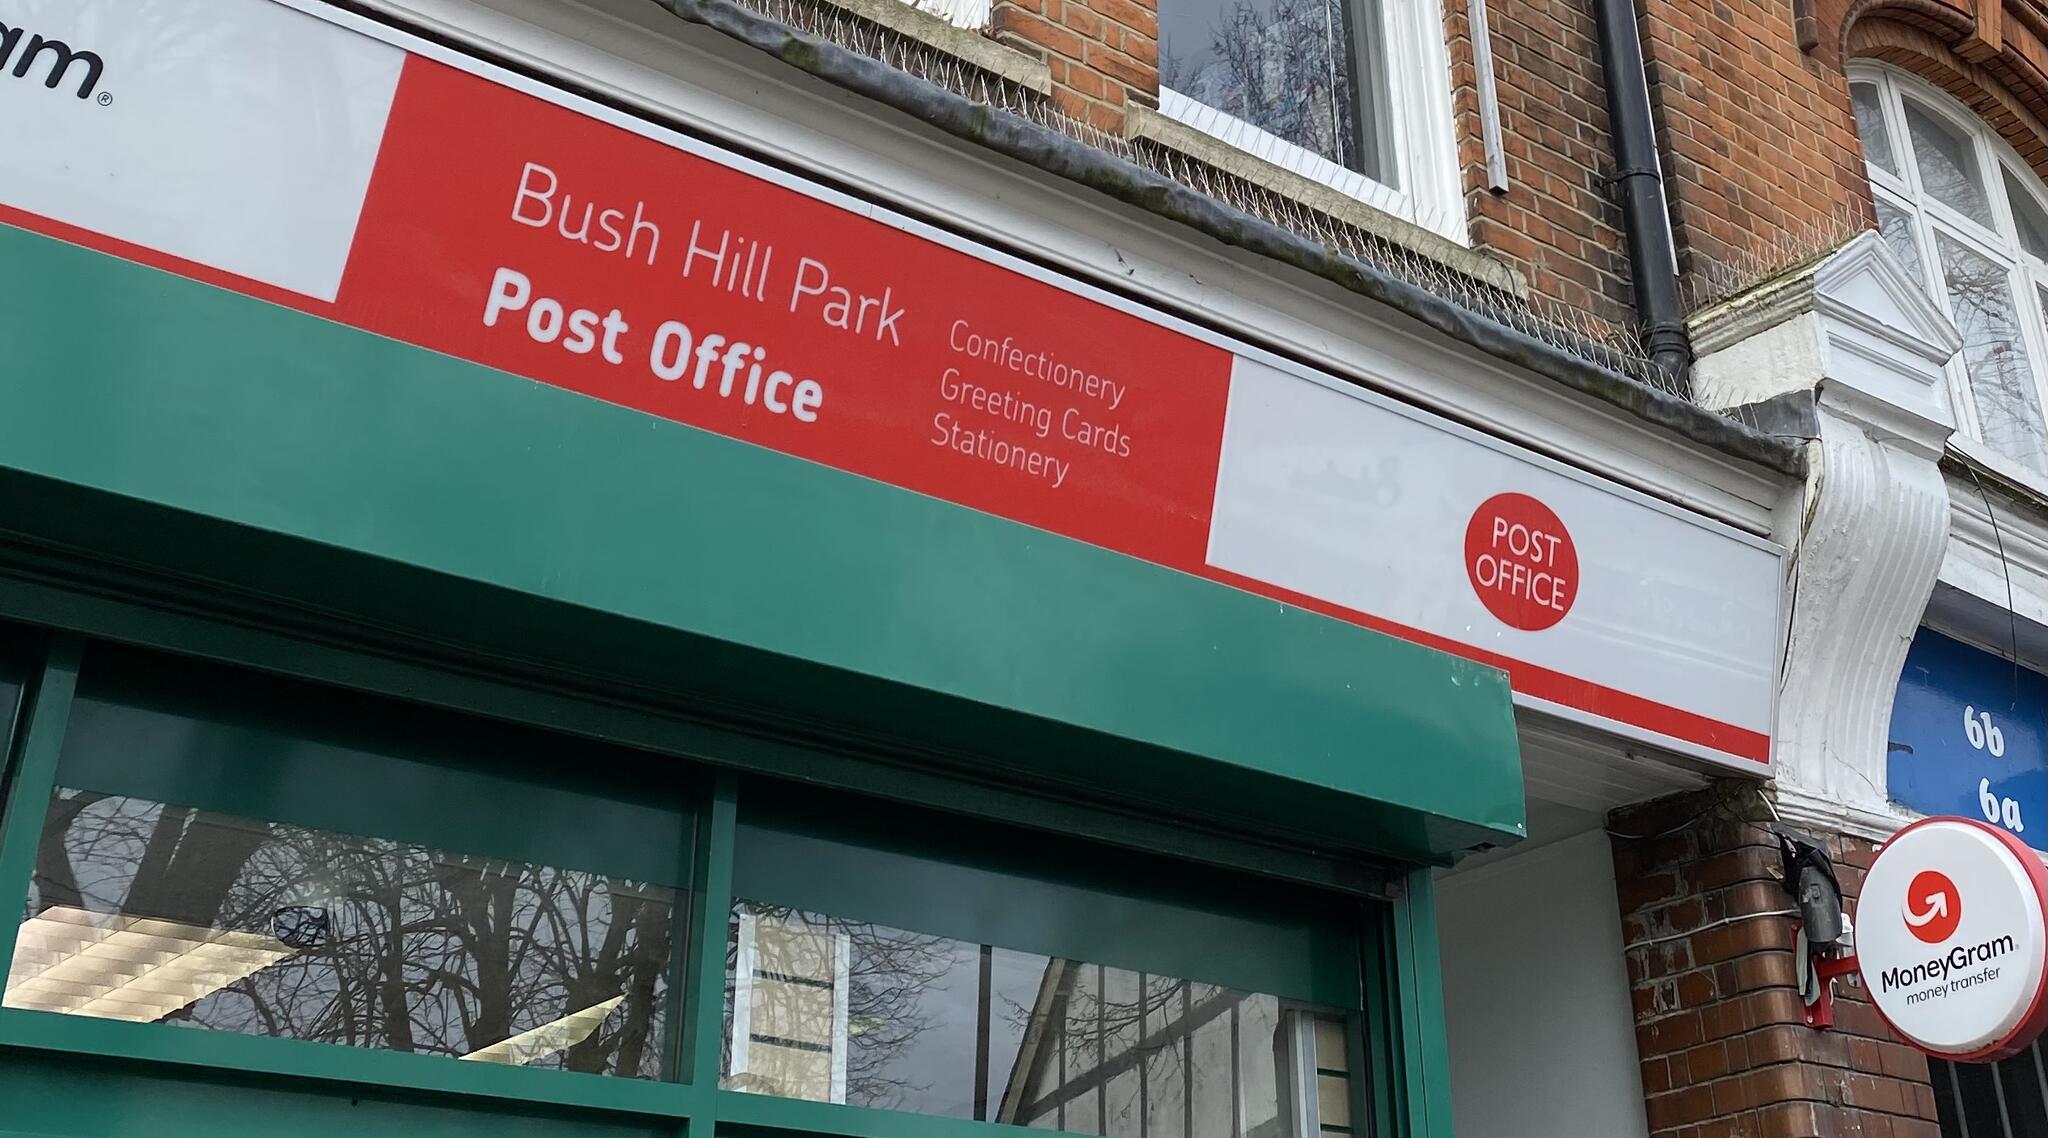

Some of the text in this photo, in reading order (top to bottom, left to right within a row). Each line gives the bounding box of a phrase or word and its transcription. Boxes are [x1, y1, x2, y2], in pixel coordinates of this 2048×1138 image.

[511, 161, 906, 347] Bush Hill Park
[482, 266, 824, 423] Post Office
[949, 319, 1127, 409] Confectionery
[939, 367, 1131, 458] Greeting Cards
[930, 412, 1070, 488] Stationery
[1492, 516, 1562, 567] POST
[1475, 553, 1566, 611] OFFICE
[1963, 705, 2005, 758] 6b
[1979, 777, 2024, 833] 6a
[1881, 934, 2014, 994] MoneyGram
[1906, 966, 2001, 1006] money transfer
